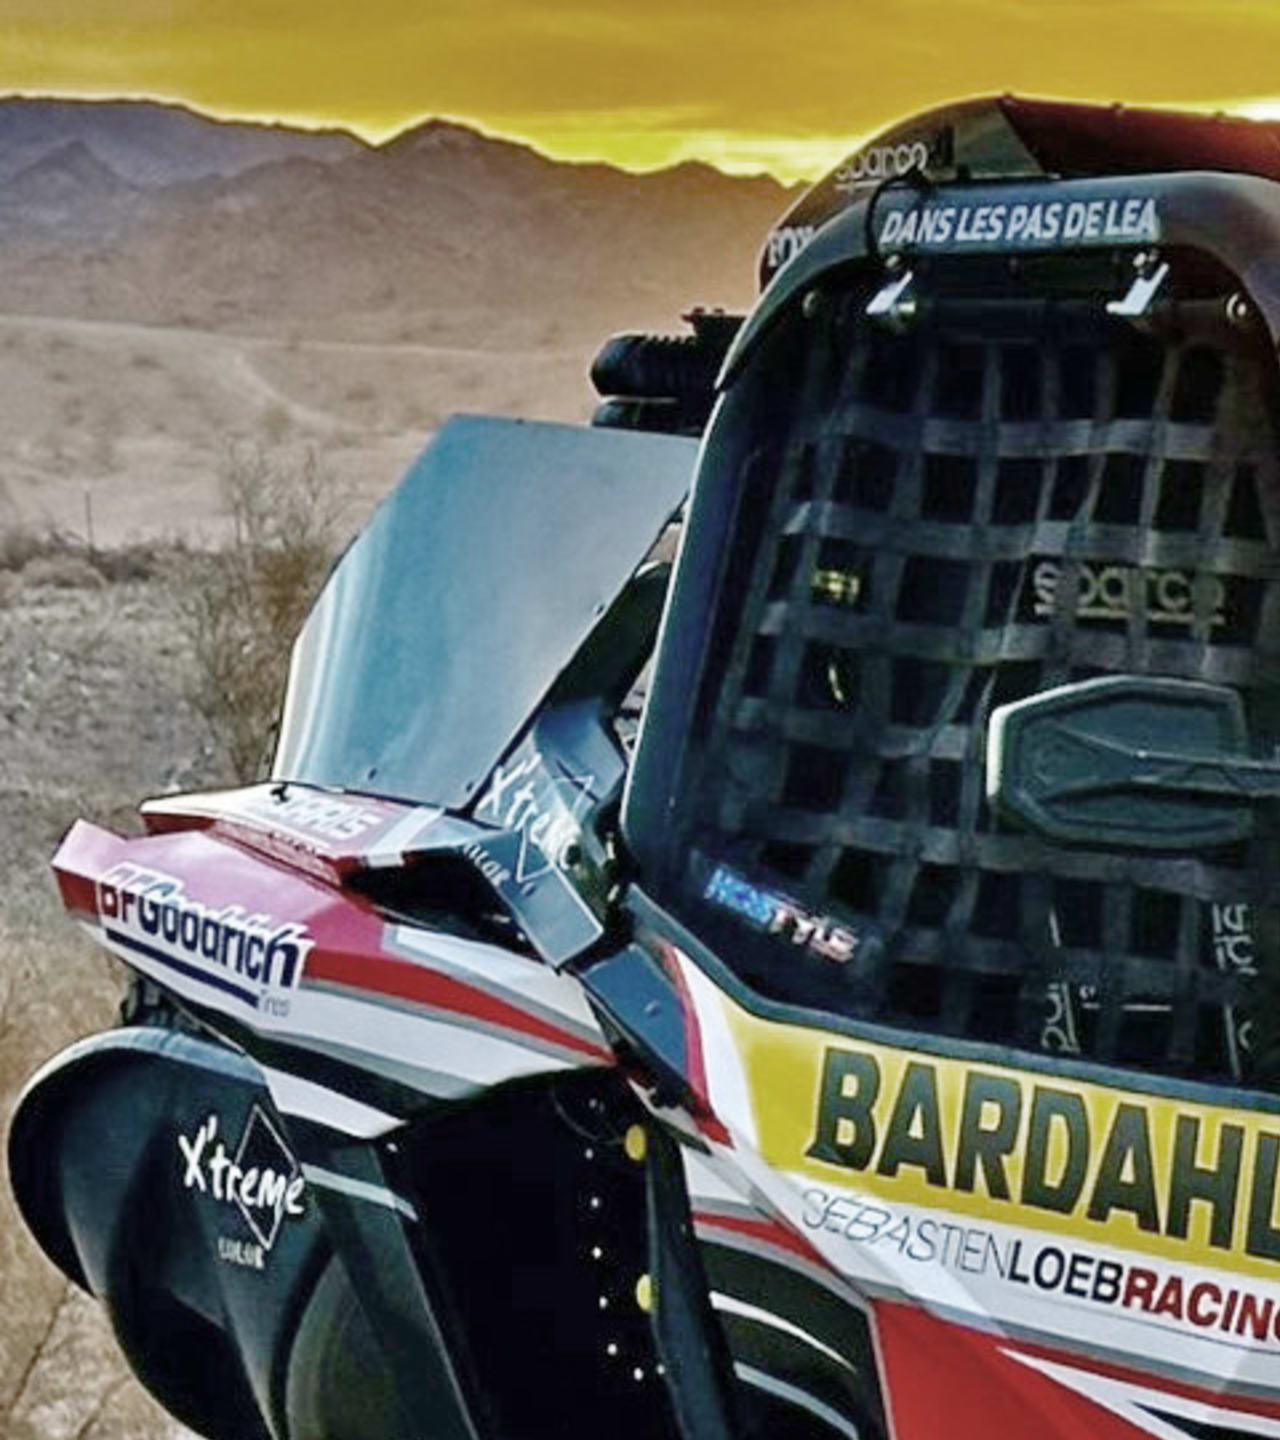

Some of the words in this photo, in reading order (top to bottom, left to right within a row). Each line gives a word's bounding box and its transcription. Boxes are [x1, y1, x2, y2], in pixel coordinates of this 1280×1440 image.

[880, 210, 954, 244] DANS
[954, 203, 1006, 241] LES
[1002, 201, 1063, 240] PAS
[1062, 200, 1106, 238] DE
[1103, 198, 1158, 236] LEA
